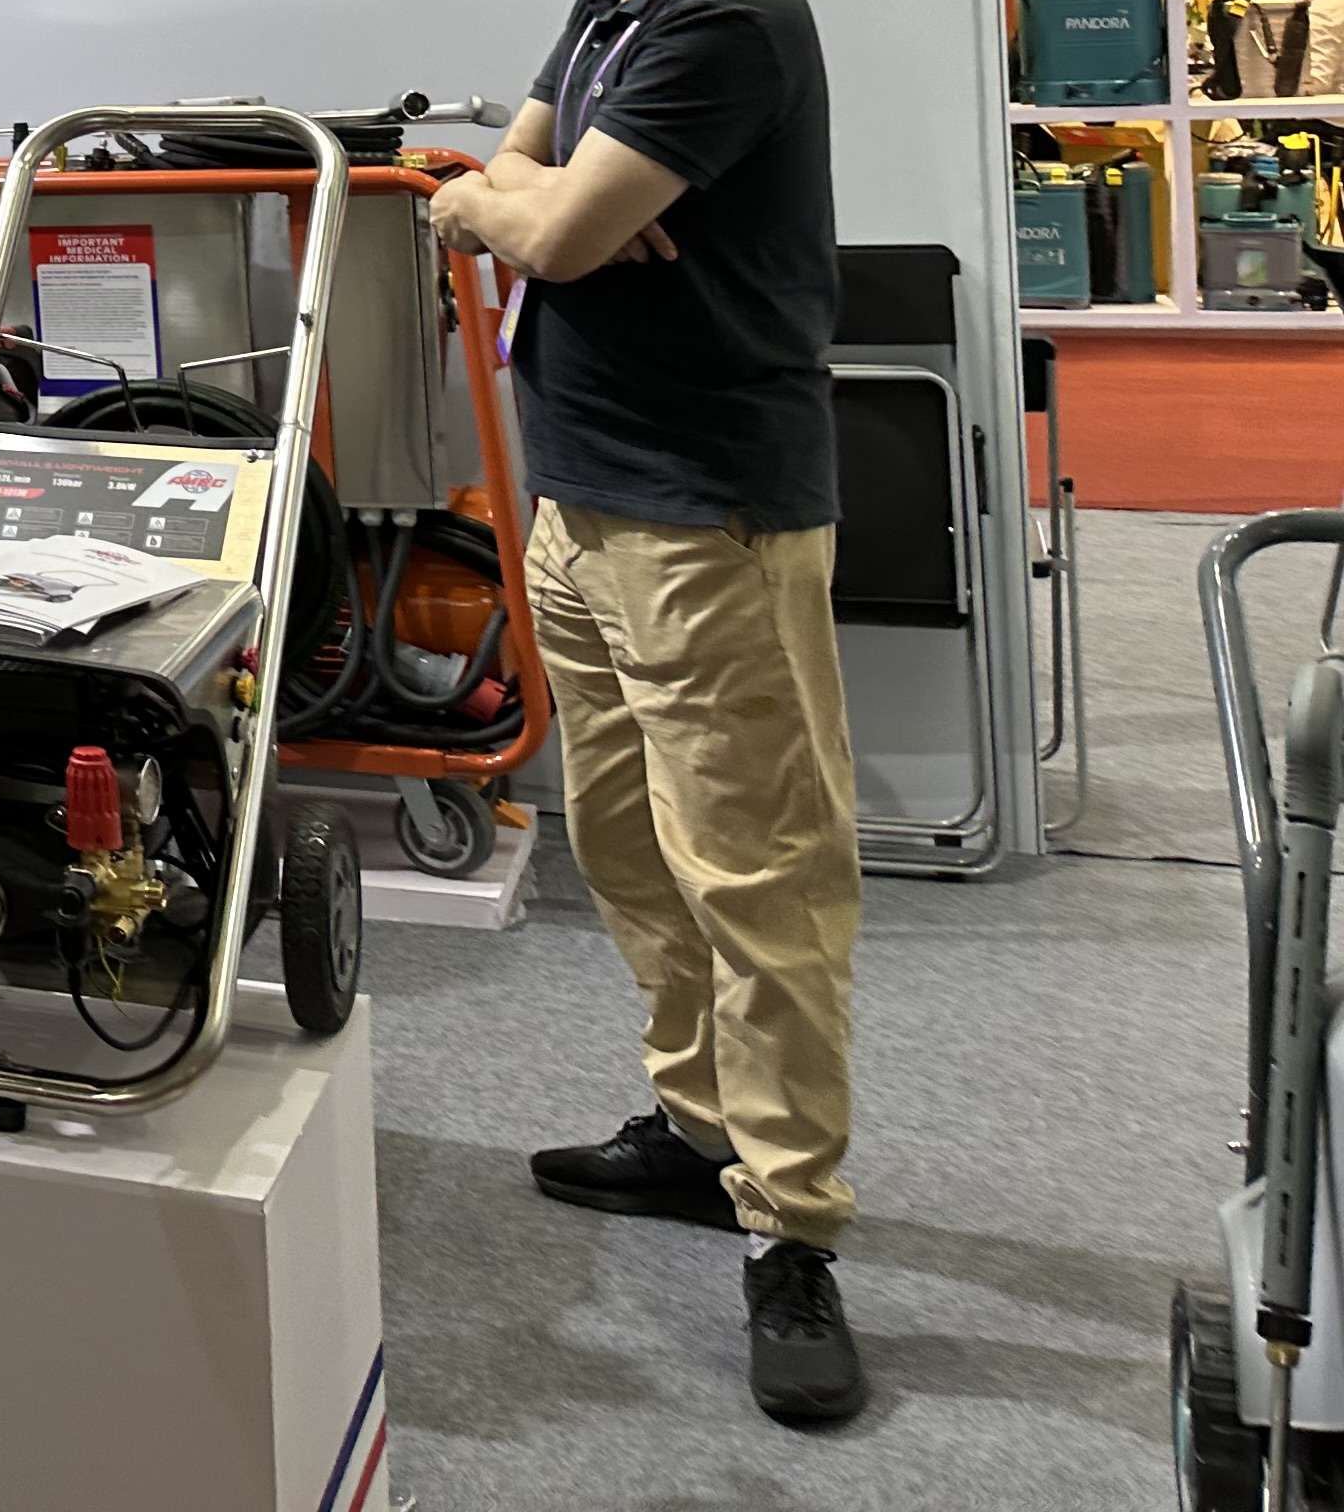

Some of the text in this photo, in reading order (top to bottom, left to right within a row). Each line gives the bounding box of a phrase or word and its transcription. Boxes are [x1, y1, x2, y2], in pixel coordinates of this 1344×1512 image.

[1065, 15, 1131, 30] PANDORA
[1014, 226, 1061, 240] NDORA
[57, 237, 125, 247] IMPORTANT
[66, 246, 118, 255] MEDICAL
[49, 254, 130, 263] INFORMATION
